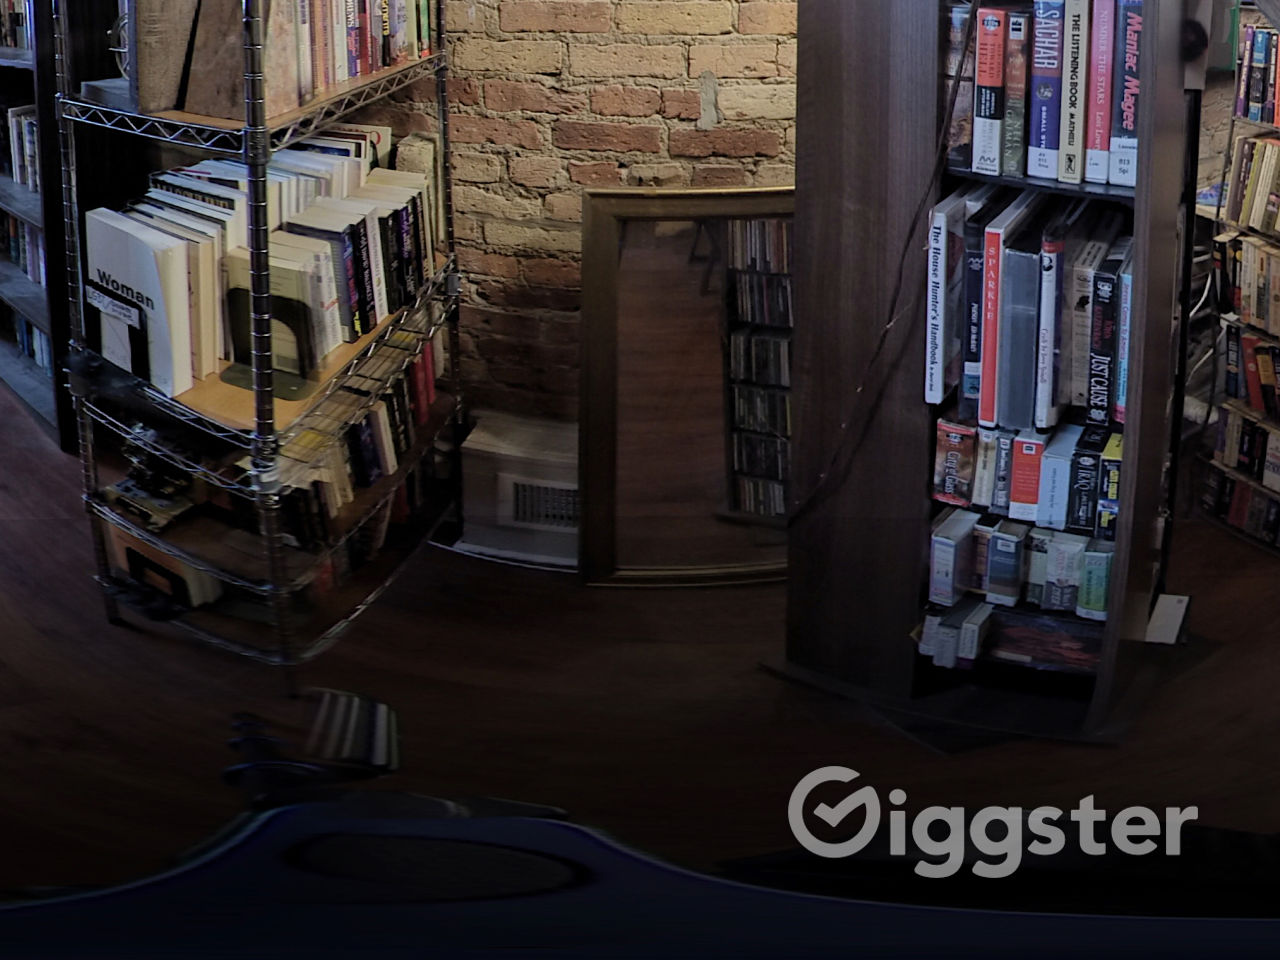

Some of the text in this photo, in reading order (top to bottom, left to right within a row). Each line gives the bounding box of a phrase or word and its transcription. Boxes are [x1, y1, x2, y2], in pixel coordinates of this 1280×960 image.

[1034, 9, 1060, 70] SACHAR
[1099, 9, 1109, 52] NUMBER
[1124, 11, 1143, 72] Maniac
[979, 42, 989, 78] HELL
[1097, 54, 1107, 75] THE
[1067, 13, 1081, 147] THE LISTENING BOOK MATHIEU
[1096, 76, 1107, 106] STARS
[1040, 105, 1048, 133] SMALL
[1096, 111, 1105, 128] Lois
[1120, 74, 1141, 132] Magee
[1004, 109, 1014, 158] GAIMAN
[1013, 120, 1021, 148] NEIL
[932, 225, 942, 244] The
[931, 246, 942, 279] House
[96, 267, 155, 311] Woman
[929, 280, 940, 321] Hunter's
[928, 322, 939, 366] Handbook
[1089, 352, 1111, 407] JUST CAUSE
[943, 451, 960, 469] City
[944, 475, 968, 494] Glass
[1074, 469, 1095, 490] IRAQ
